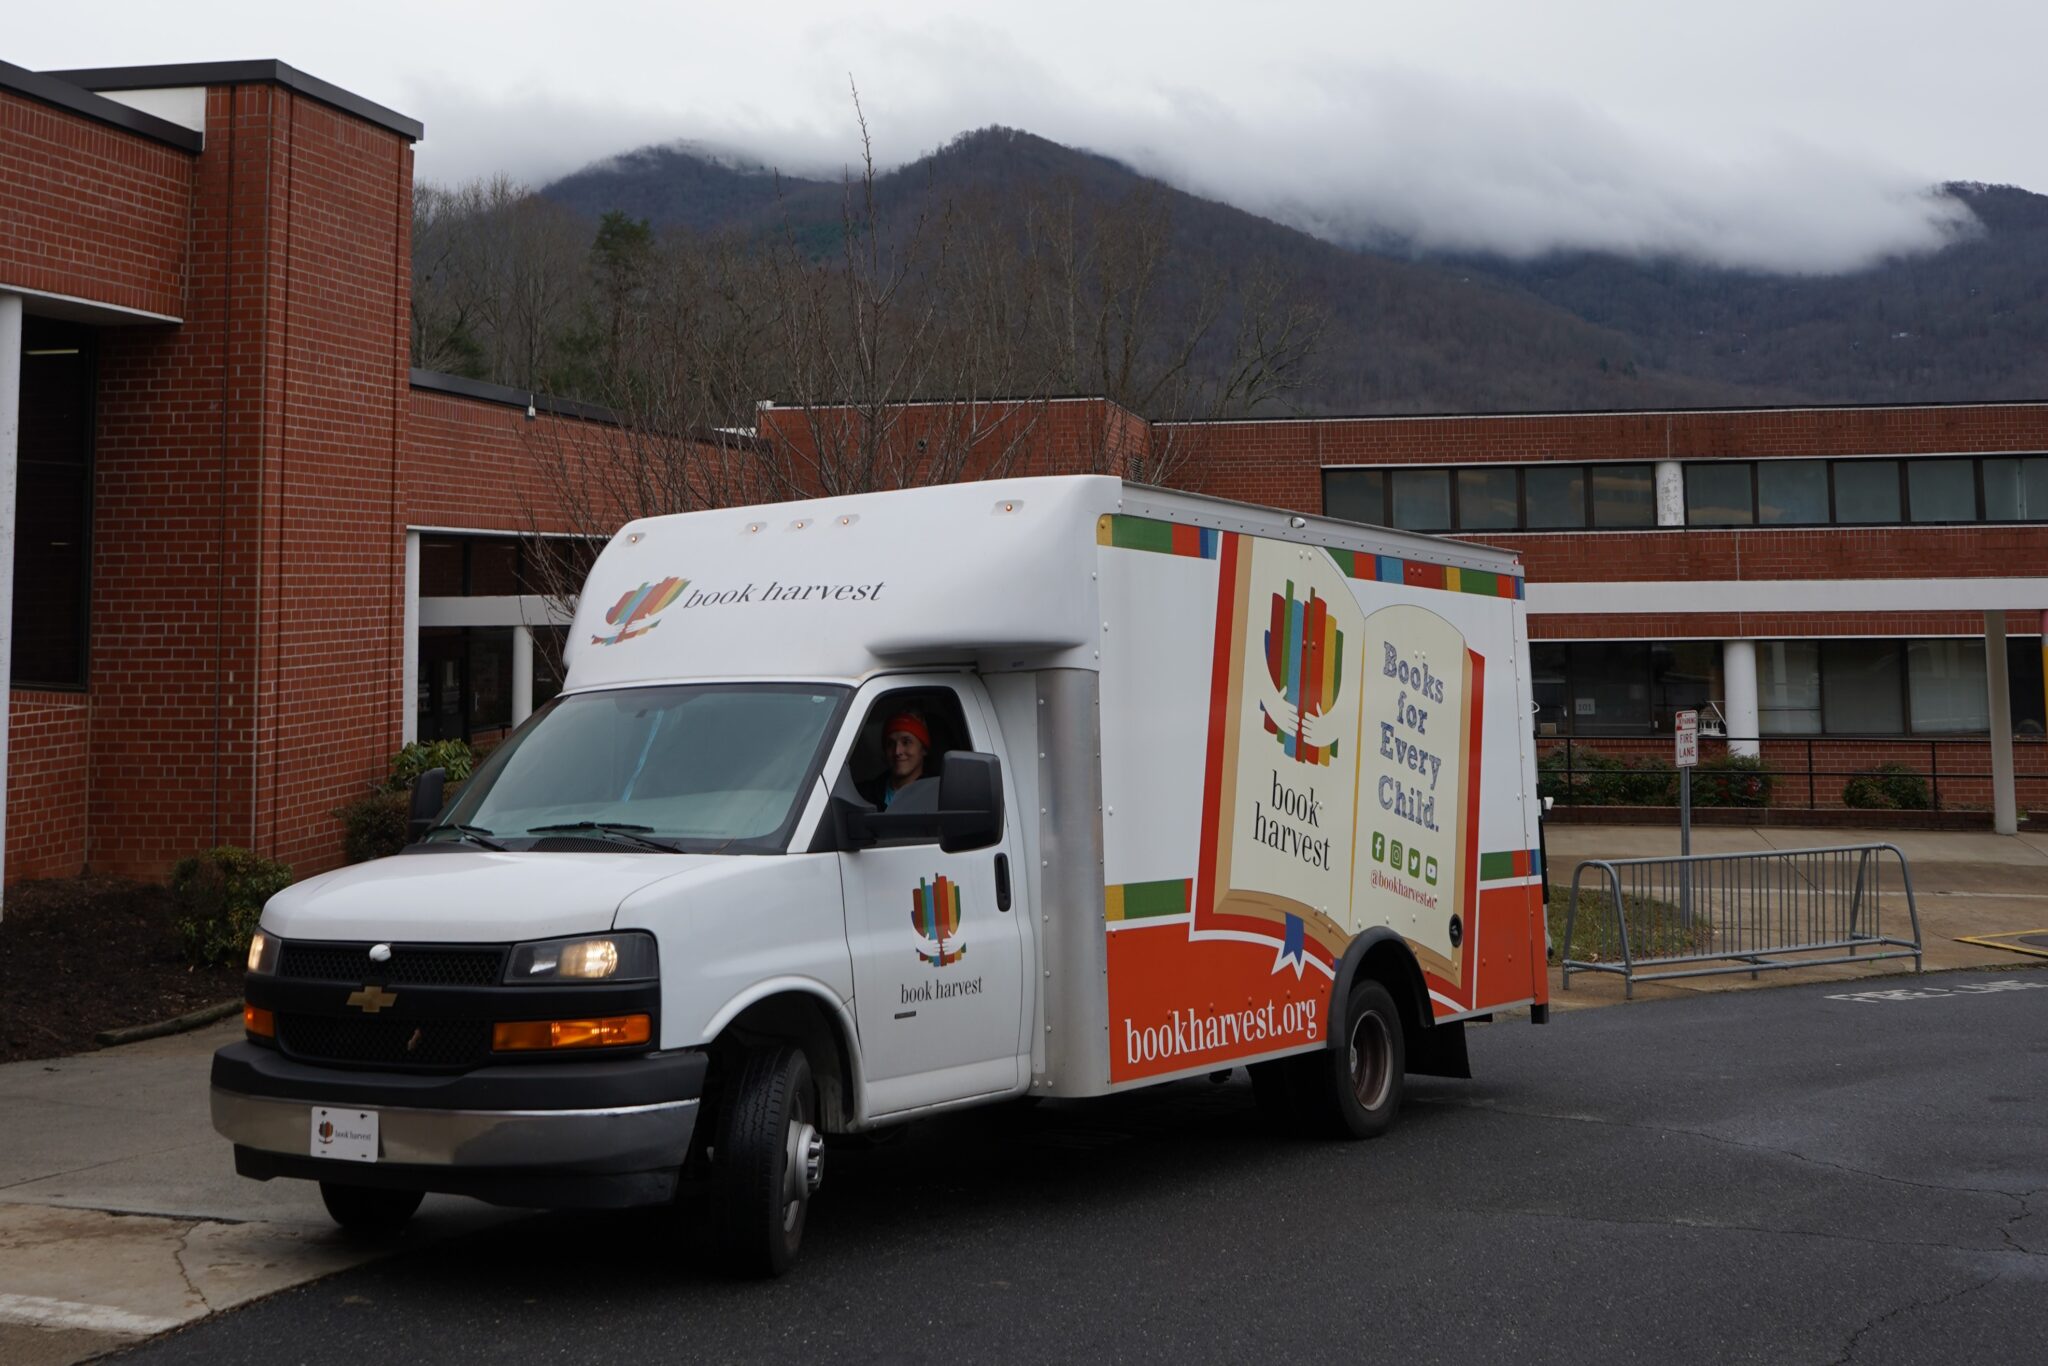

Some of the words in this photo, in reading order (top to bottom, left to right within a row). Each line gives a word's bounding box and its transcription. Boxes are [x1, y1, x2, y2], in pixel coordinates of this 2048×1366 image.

[683, 583, 756, 609] book
[760, 581, 886, 602] harvest
[1383, 640, 1444, 704] Books
[1397, 690, 1428, 735] for
[1380, 720, 1442, 790] Every
[1271, 768, 1319, 828] book
[1378, 774, 1439, 832] Child.
[1253, 800, 1331, 872] harvest
[900, 980, 933, 1004] book
[935, 975, 983, 1000] harvest
[1124, 999, 1317, 1065] bookharvest.org
[335, 1130, 349, 1139] book
[350, 1131, 372, 1141] harvest
